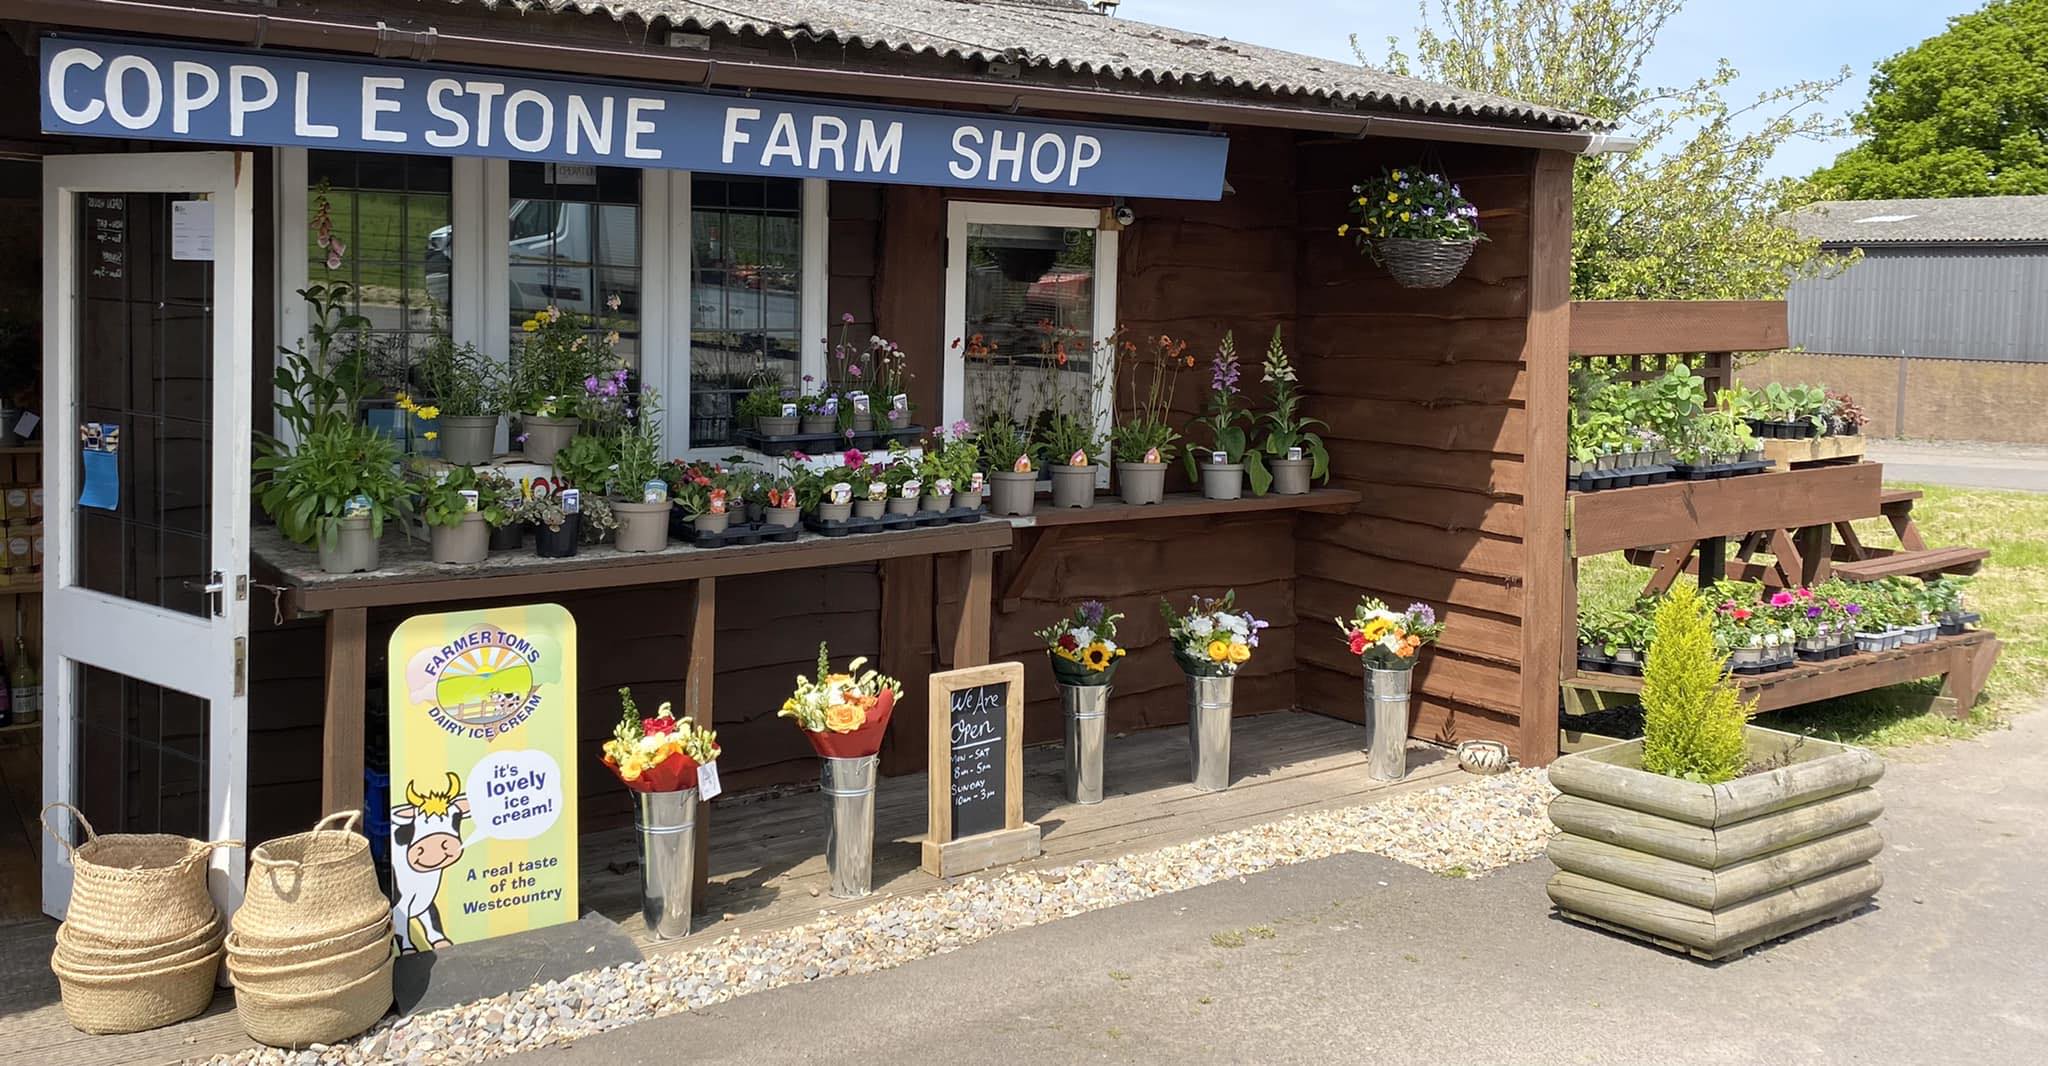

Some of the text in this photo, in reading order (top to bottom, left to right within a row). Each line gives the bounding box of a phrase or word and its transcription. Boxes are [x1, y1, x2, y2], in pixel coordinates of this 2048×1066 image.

[48, 48, 1102, 187] COPPLESTONE FARM SHOP
[425, 630, 540, 676] FARMER TOM'S
[951, 686, 999, 715] We Are
[428, 694, 542, 739] DAIRY ICE CREAM
[951, 719, 995, 744] Open
[974, 747, 990, 760] SAT
[486, 770, 546, 798] lovely
[493, 764, 519, 779] it's
[492, 798, 553, 826] cream!
[504, 795, 530, 810] ice
[466, 855, 558, 882] A real taste
[490, 875, 536, 894] of the
[463, 887, 562, 915] Westcountry
